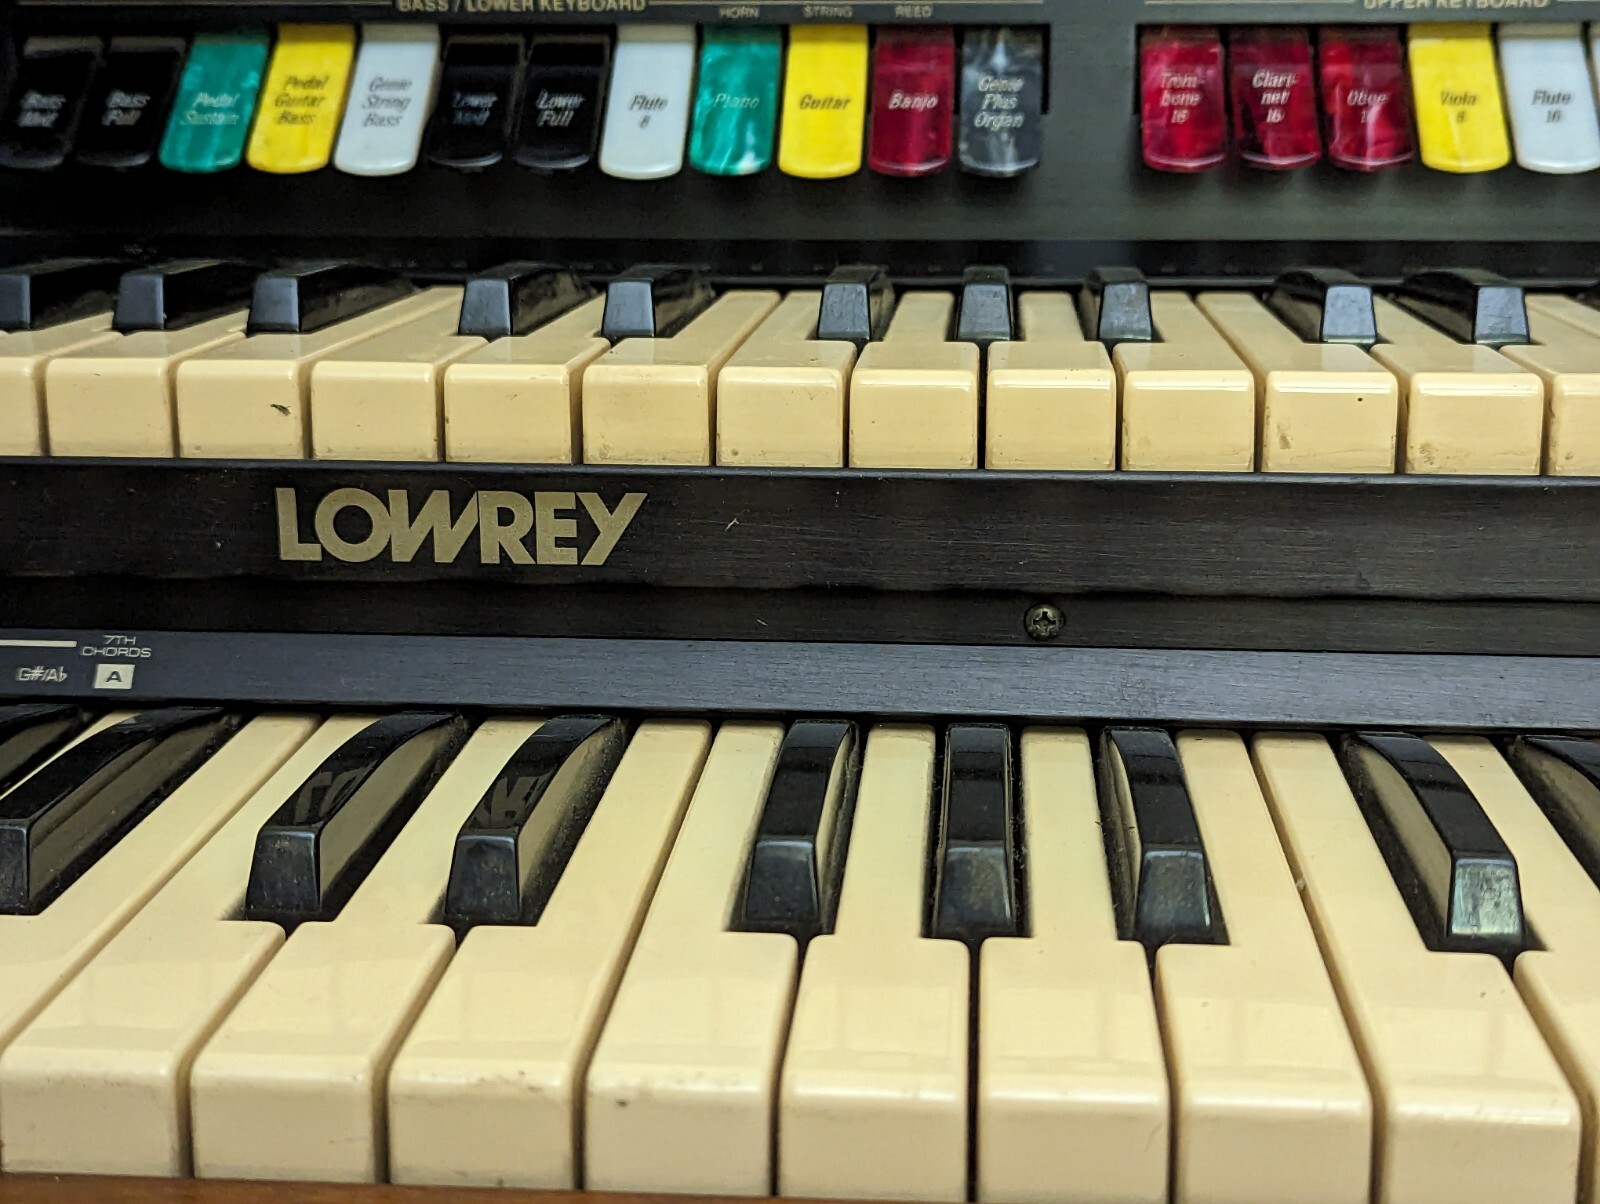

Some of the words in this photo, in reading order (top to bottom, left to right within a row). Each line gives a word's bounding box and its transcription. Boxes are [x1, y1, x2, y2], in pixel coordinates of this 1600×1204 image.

[539, 0, 646, 12] KEYBOARD
[719, 6, 760, 18] HORN
[804, 6, 853, 18] STRING
[895, 5, 933, 17] REED
[628, 93, 668, 110] Flute
[713, 92, 760, 109] Piano
[800, 94, 852, 110] Guitar
[888, 90, 939, 112] Banjo
[981, 93, 1018, 110] Plus
[1532, 89, 1572, 106] Flute
[974, 111, 1025, 131] Organ
[275, 486, 648, 566] LOWREY
[104, 635, 137, 646] 7TH
[81, 646, 152, 658] CHORDS
[105, 670, 123, 683] A
